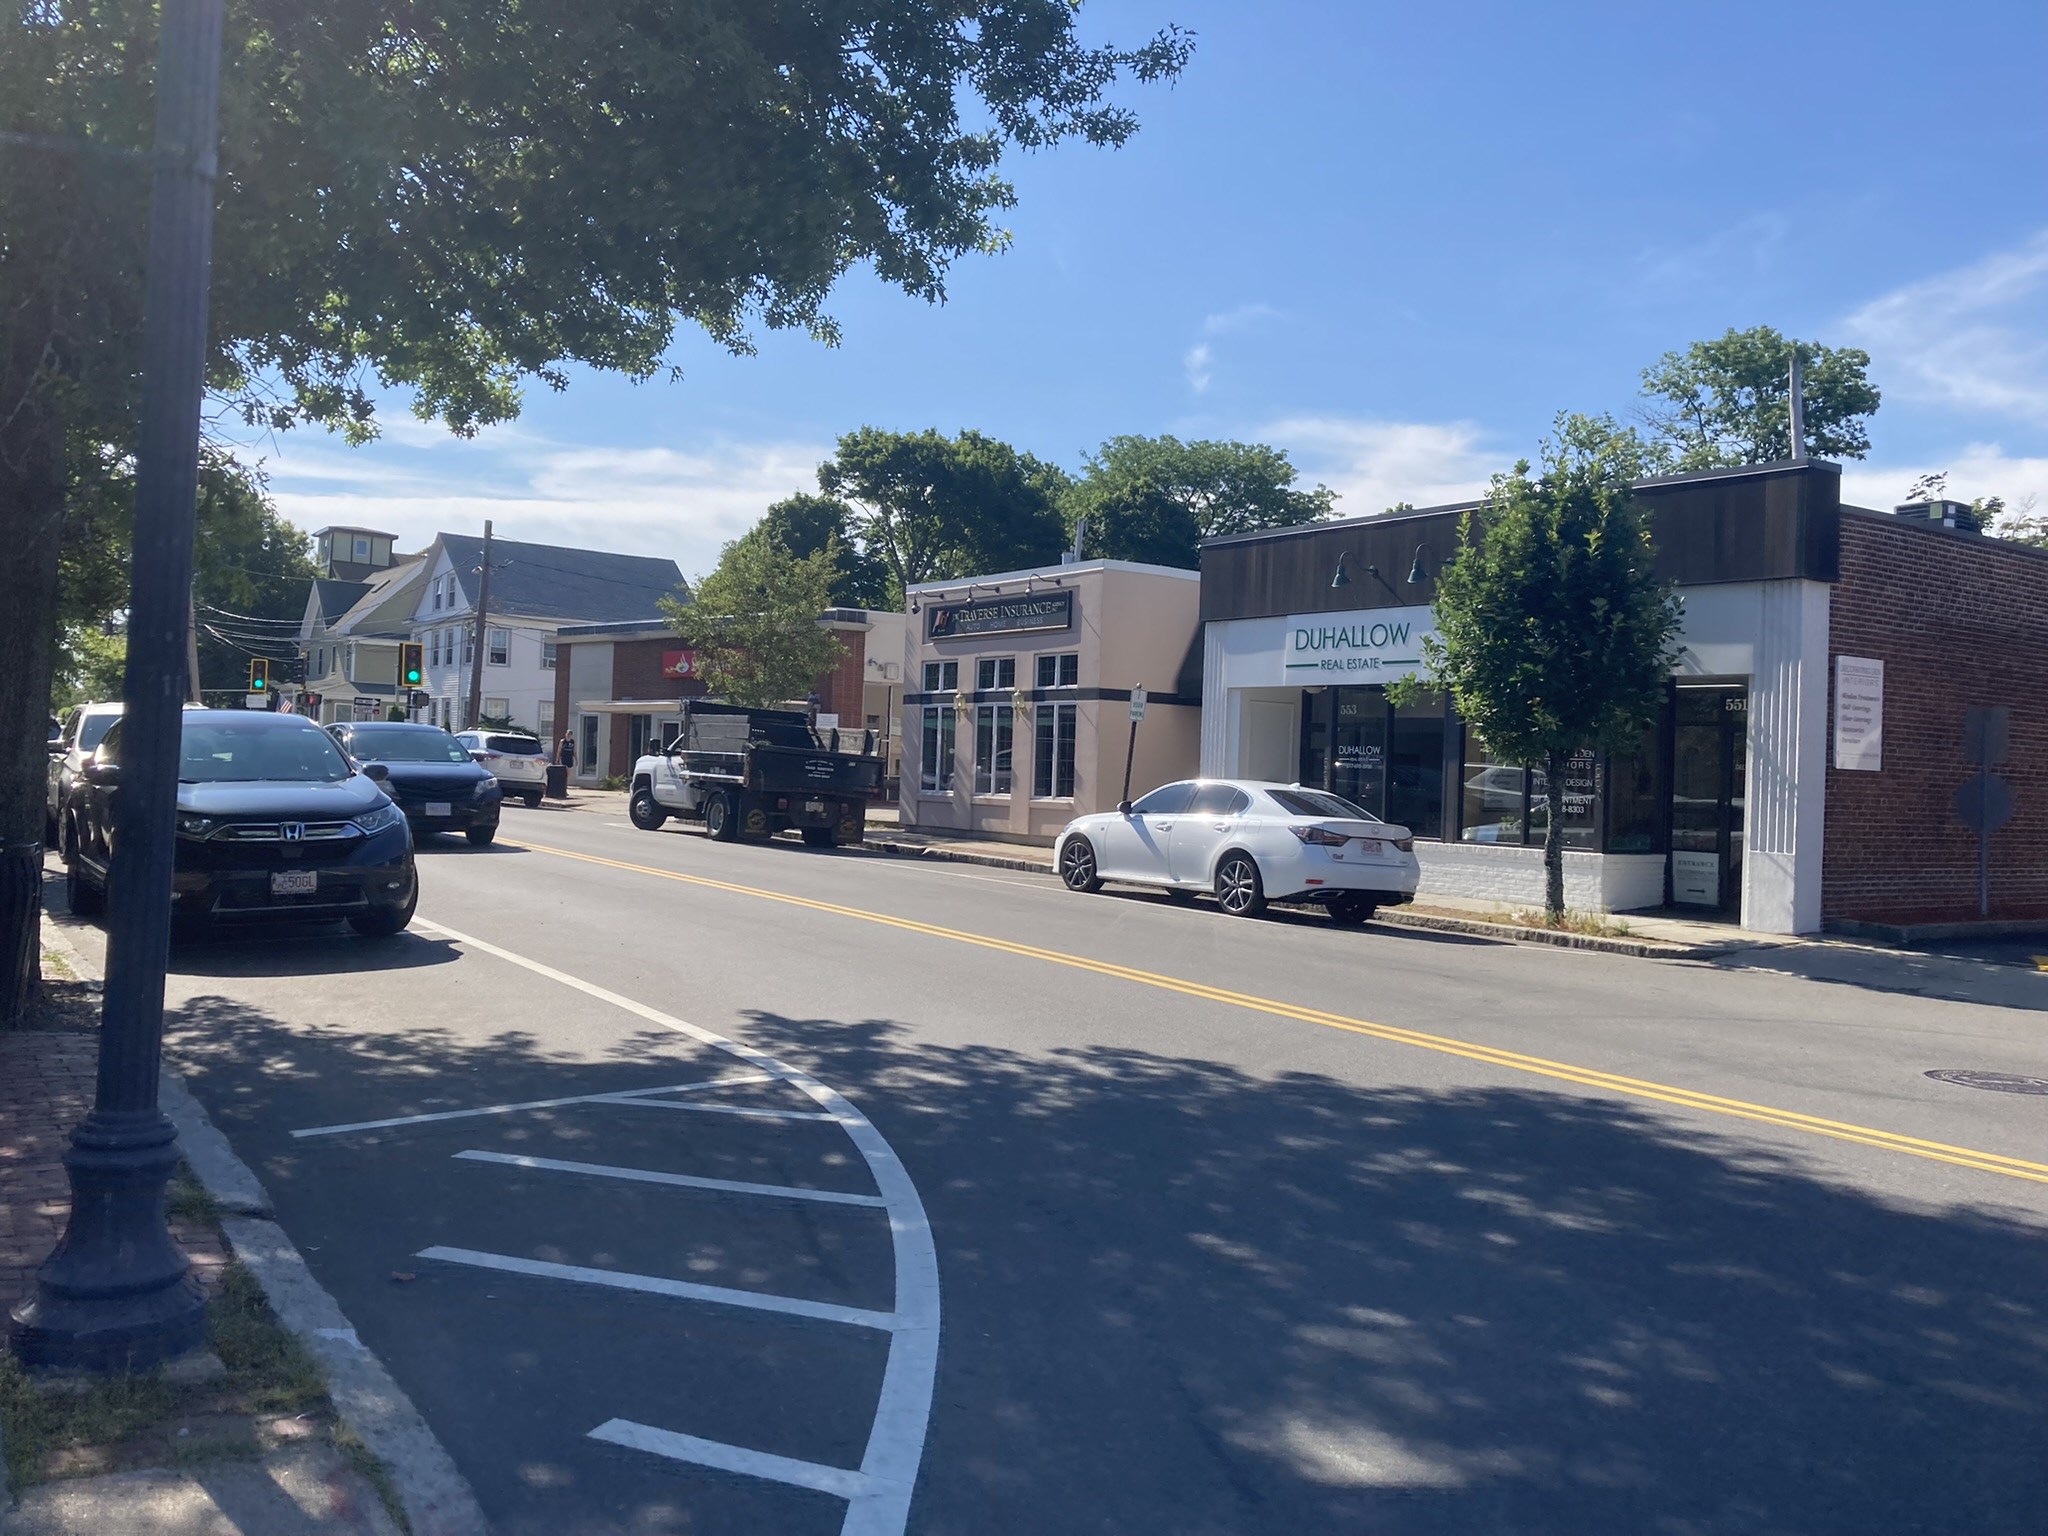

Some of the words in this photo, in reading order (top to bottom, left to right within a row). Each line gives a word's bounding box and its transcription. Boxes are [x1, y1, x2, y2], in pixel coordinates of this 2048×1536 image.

[960, 607, 998, 622] TRAVERSE
[1000, 601, 1052, 619] INSURANCE
[990, 621, 1006, 629] HOME
[1016, 616, 1044, 627] BUSINESS
[1295, 622, 1410, 651] DUHALLOW
[1321, 659, 1344, 670] REAL
[1346, 657, 1380, 669] ESTATE
[1340, 704, 1357, 715] 553
[1725, 699, 1748, 711] 551
[1338, 745, 1381, 755] DUHALLOW
[1565, 778, 1593, 787] DESIGN
